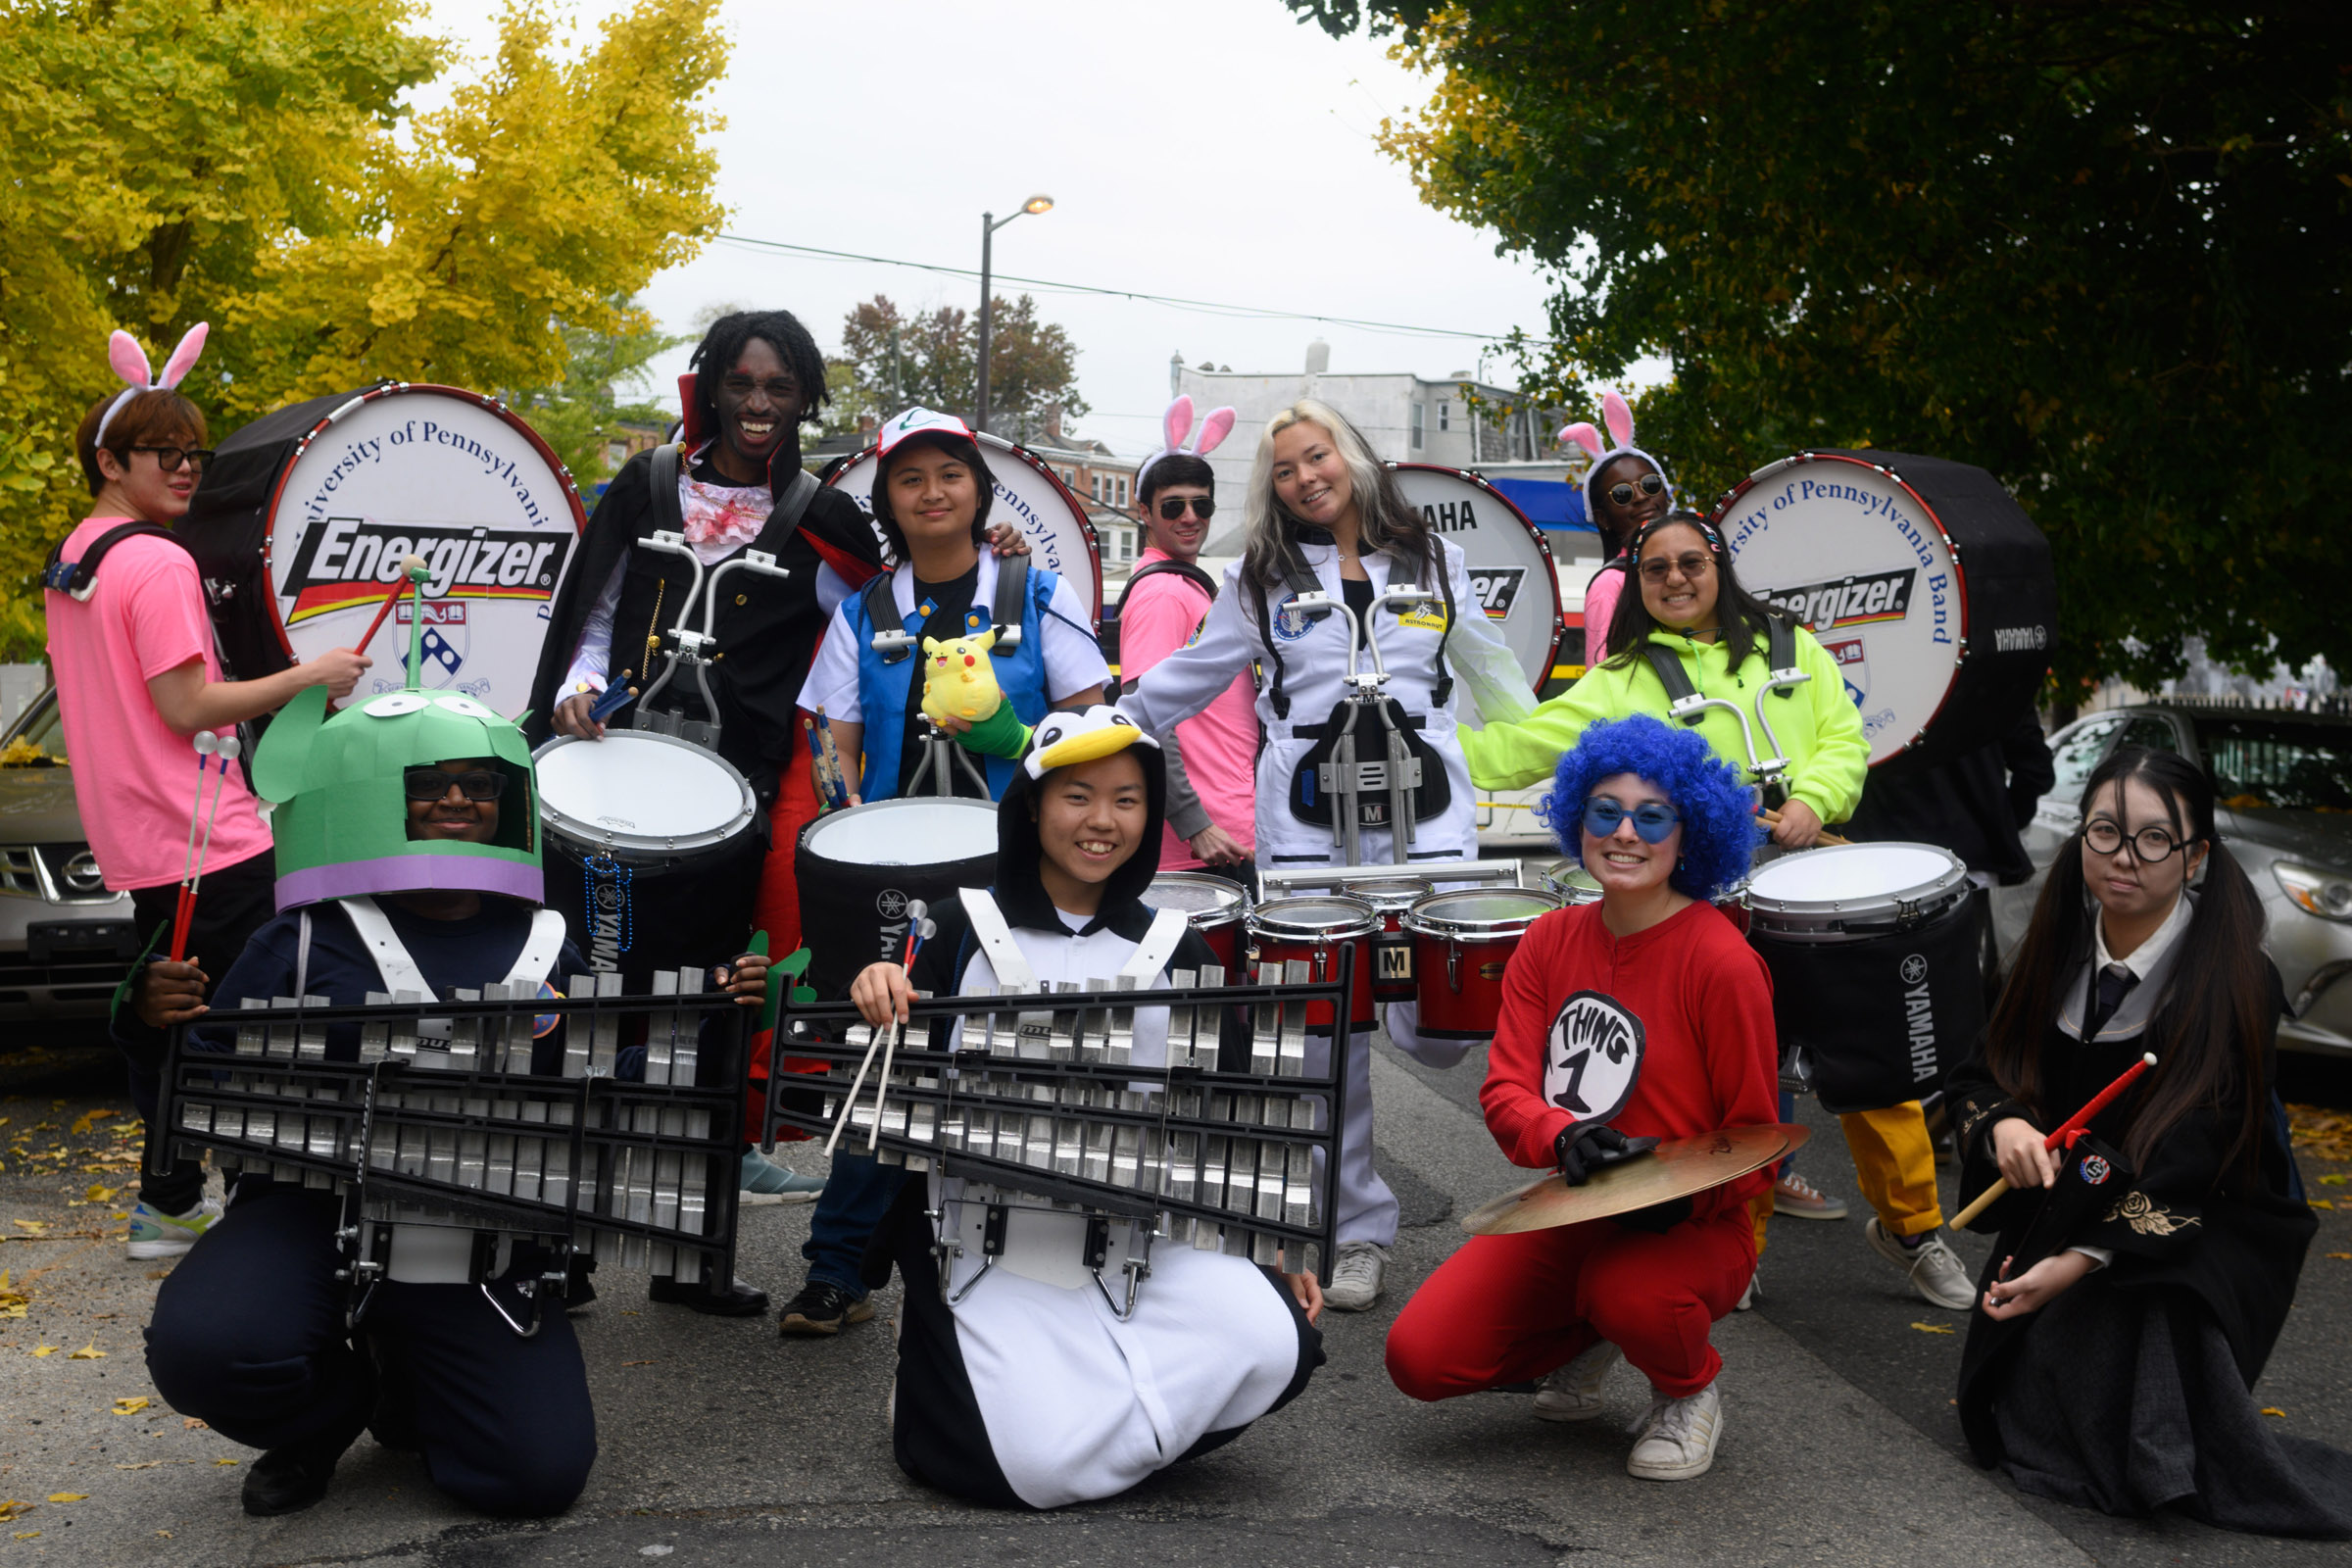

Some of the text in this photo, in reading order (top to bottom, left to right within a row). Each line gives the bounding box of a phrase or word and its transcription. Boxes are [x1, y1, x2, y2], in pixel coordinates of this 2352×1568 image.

[296, 420, 550, 545] iversity of Pennsylvani
[994, 483, 1063, 575] ennsylva
[1422, 500, 1478, 533] AHA
[1729, 479, 1952, 645] rsity of Pennsylvania Band
[1404, 618, 1444, 629] ASTRONAUT
[1994, 627, 2035, 652] YAMAHA
[1365, 806, 1382, 822] M
[590, 913, 623, 976] YAMA
[1384, 952, 1405, 972] M
[1559, 1003, 1630, 1065] THING
[1904, 982, 1938, 1083] YAMAHA
[1553, 1048, 1592, 1113] 1
